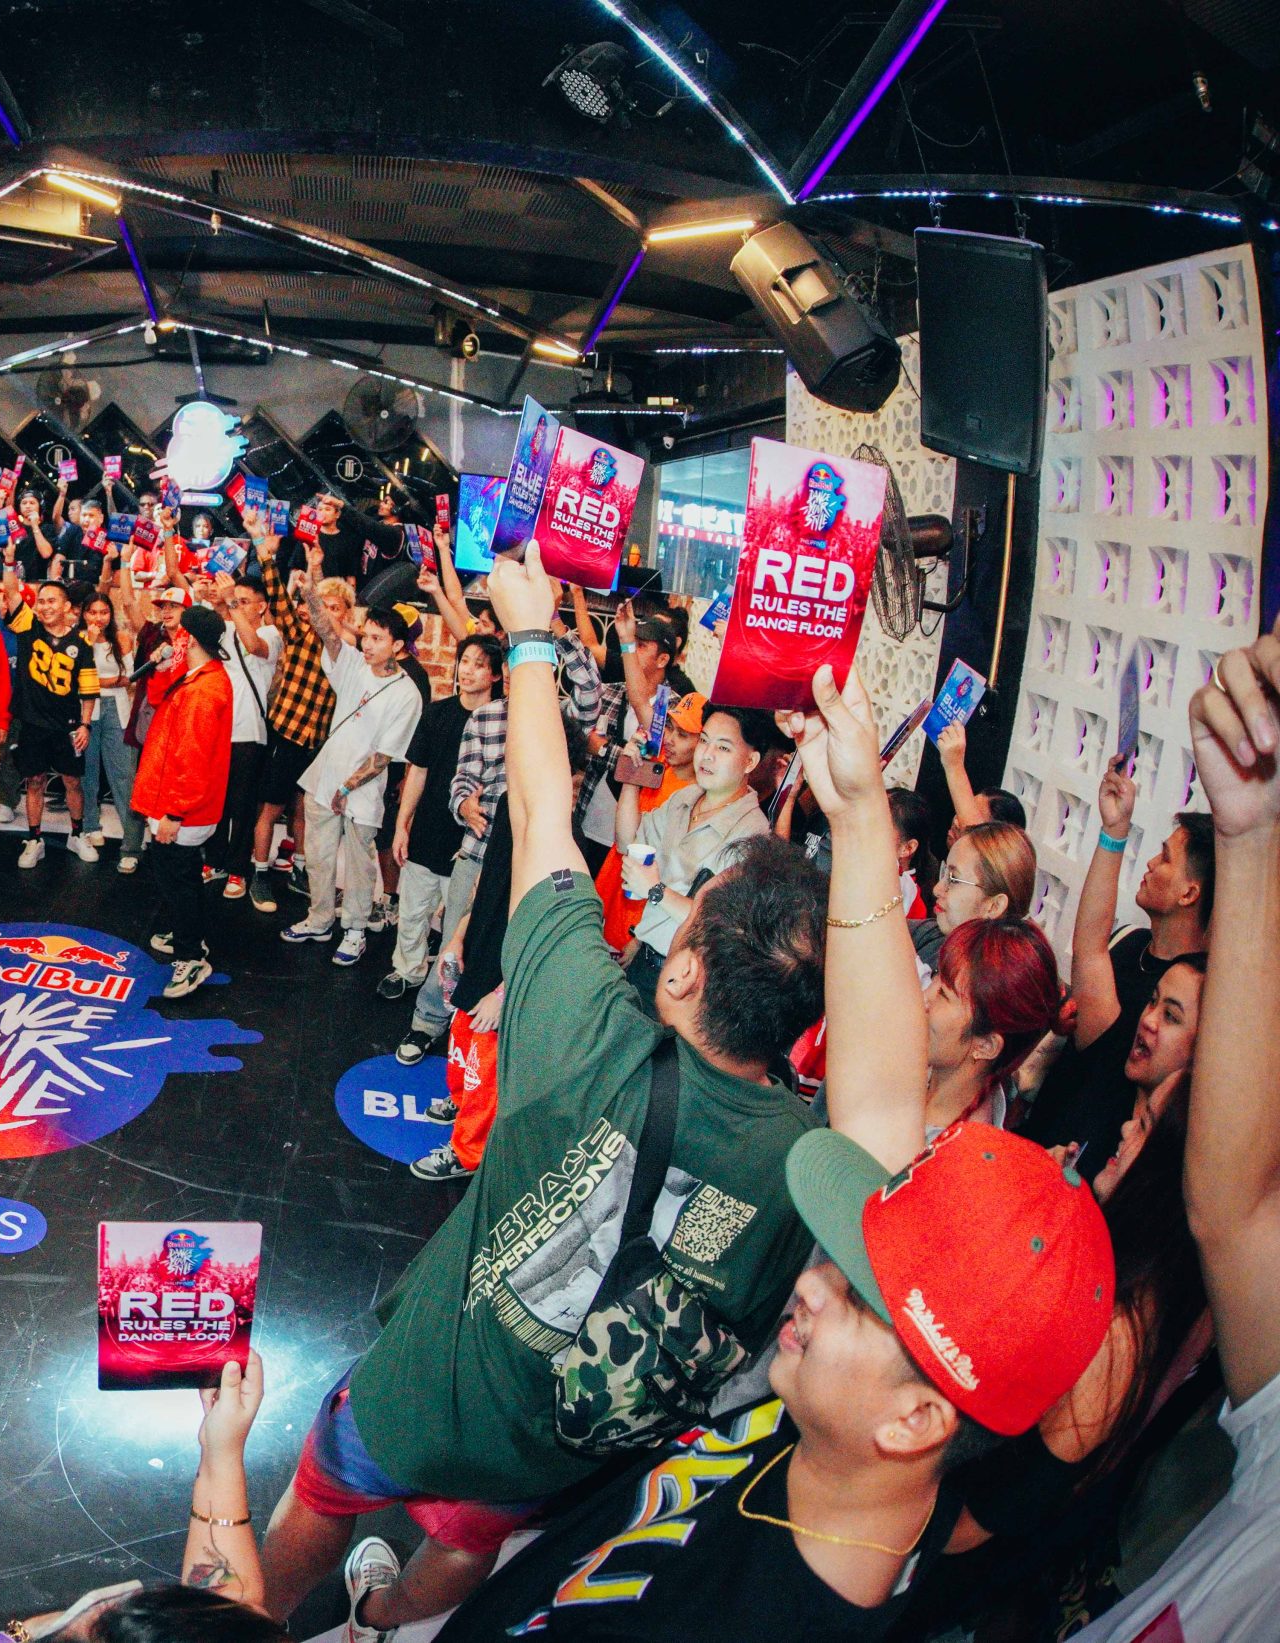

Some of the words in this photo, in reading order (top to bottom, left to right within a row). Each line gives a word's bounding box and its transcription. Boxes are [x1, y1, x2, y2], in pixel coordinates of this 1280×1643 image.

[514, 463, 543, 495] BLUE
[511, 484, 529, 502] RULES
[808, 489, 831, 503] DANCE
[555, 487, 620, 528] RED
[550, 521, 582, 540] DANCE
[583, 533, 613, 550] FLOOR
[553, 511, 591, 532] RULES
[593, 522, 616, 541] THE
[754, 548, 855, 602] RED
[750, 594, 811, 617] RULES
[815, 603, 848, 622] THE
[745, 614, 796, 633] DANCE
[799, 621, 844, 639] FLOOR
[943, 693, 967, 720] BLUE
[33, 967, 135, 1002] Bull
[470, 1117, 611, 1284] EMBRACE
[169, 1249, 193, 1257] DANCE
[662, 1252, 672, 1264] We
[168, 1264, 193, 1275] STYLE
[120, 1292, 235, 1319] RED
[118, 1333, 174, 1342] DANCE
[176, 1333, 230, 1342] FLOOR
[120, 1320, 187, 1331] RULES
[189, 1320, 231, 1331] THE
[906, 1288, 954, 1350] Mitchell
[955, 1354, 980, 1391] Ness
